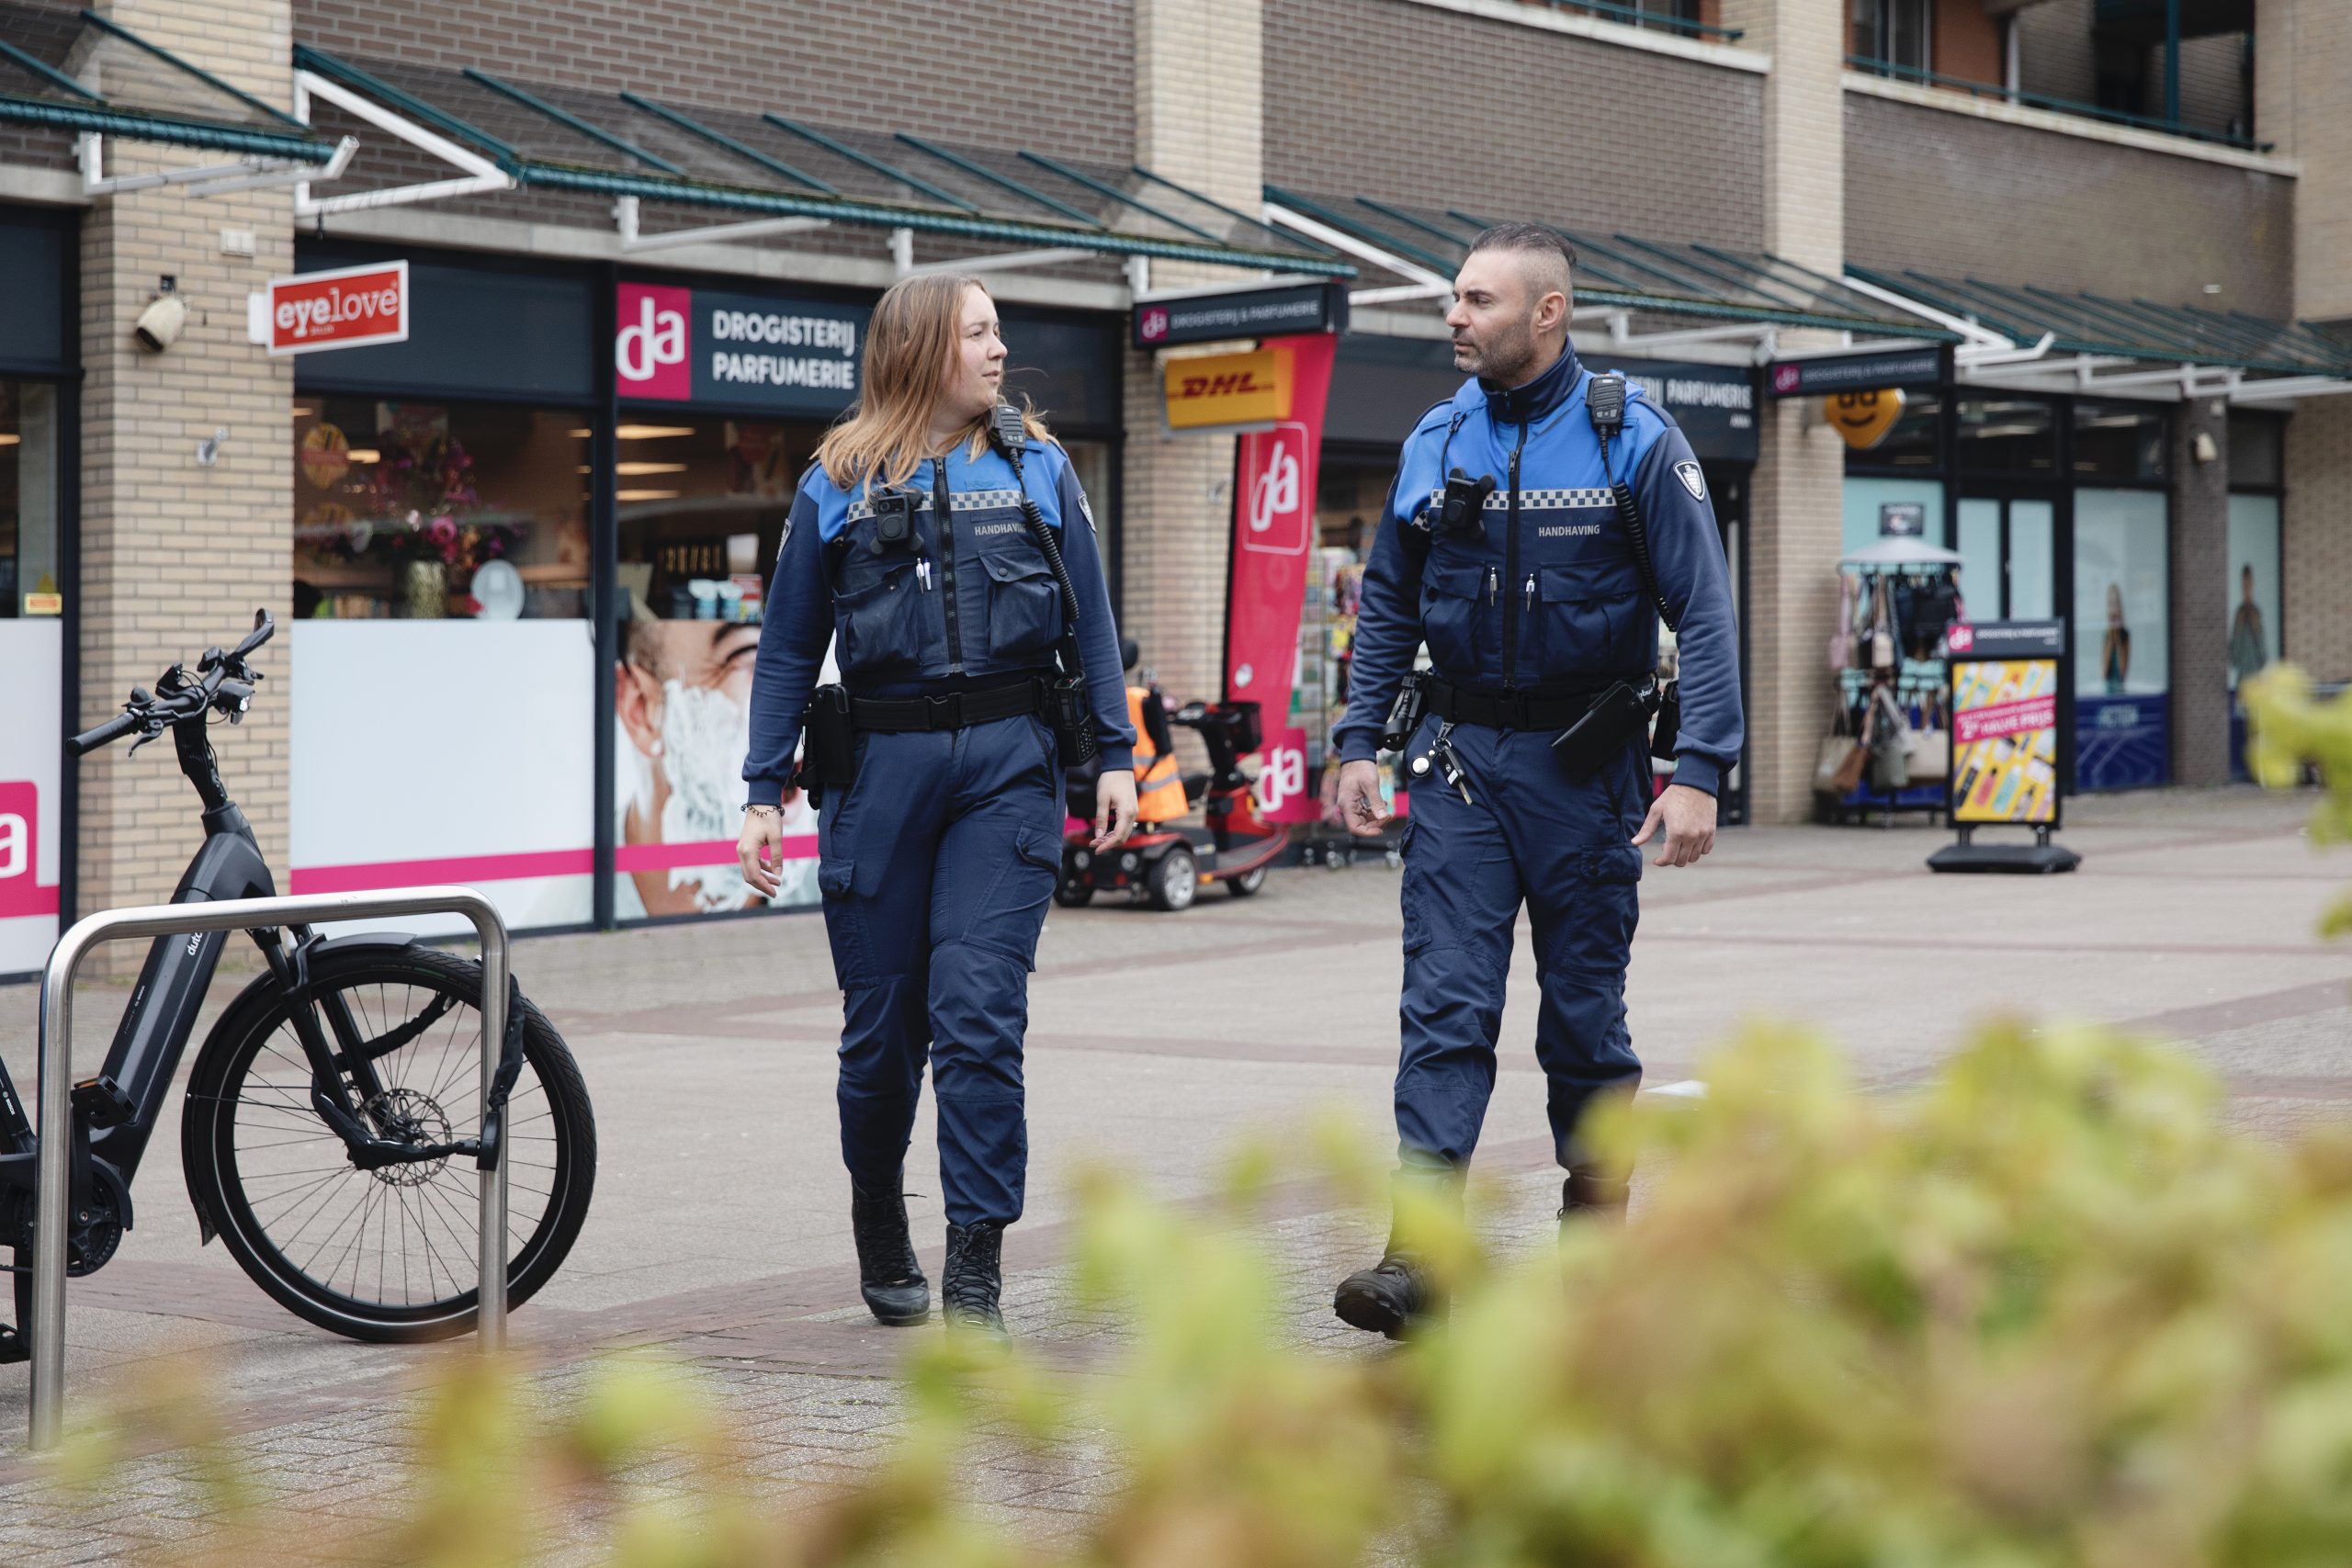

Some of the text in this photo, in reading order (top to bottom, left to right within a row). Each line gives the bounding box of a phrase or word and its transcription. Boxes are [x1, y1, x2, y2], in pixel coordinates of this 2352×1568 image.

[277, 287, 398, 338] eyelove
[712, 310, 855, 356] DROGISTERIJ
[1142, 310, 1167, 338] da
[615, 296, 685, 381] da
[712, 351, 854, 389] PARFUMERIE
[1182, 372, 1258, 398] DHL
[1666, 378, 1753, 410] PARFUMERIE
[1250, 440, 1299, 532] da
[1538, 524, 1600, 537] HANDHAVING
[1259, 743, 1305, 813] da
[0, 812, 28, 879] a
[187, 931, 203, 956] dutc
